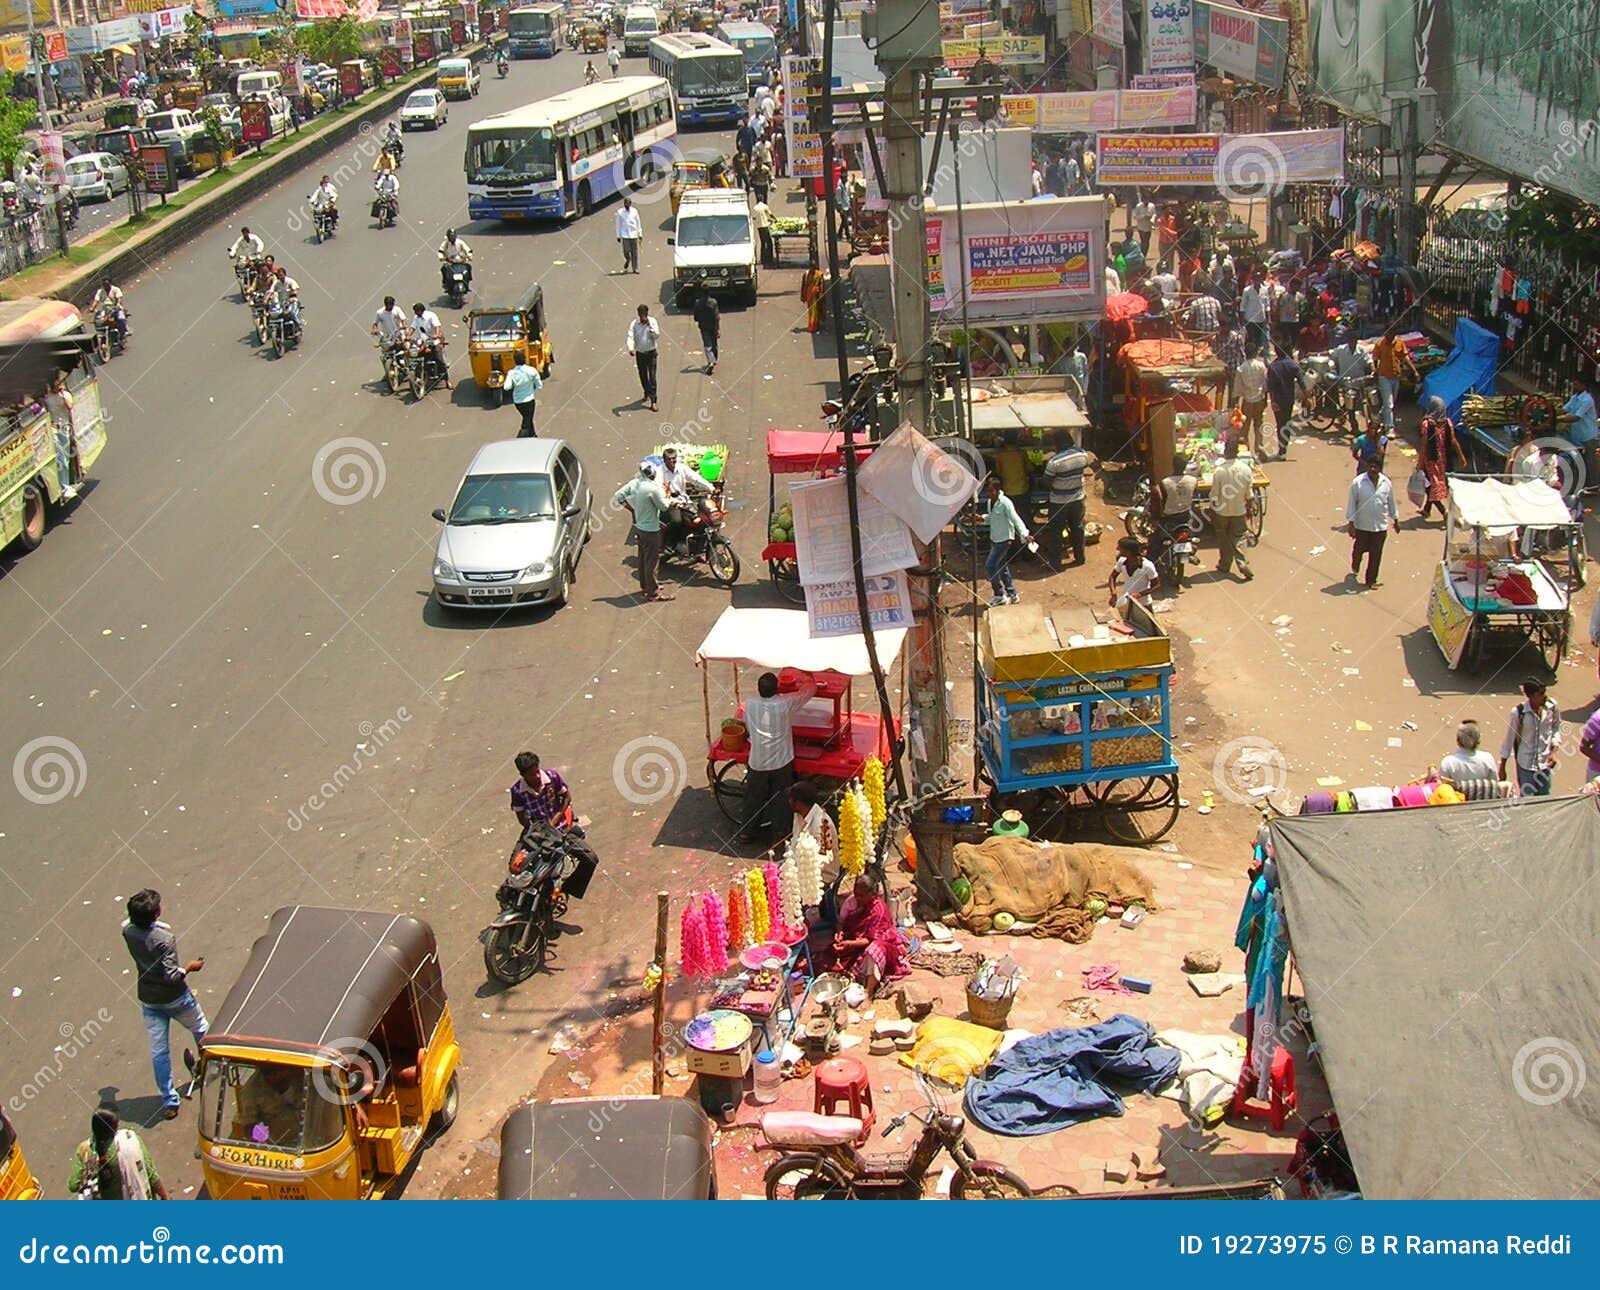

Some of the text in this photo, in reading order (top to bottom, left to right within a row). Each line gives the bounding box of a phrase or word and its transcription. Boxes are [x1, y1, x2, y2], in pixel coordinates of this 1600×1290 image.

[1003, 39, 1028, 52] SAP
[1106, 138, 1214, 147] RAMAIAH
[971, 233, 1087, 247] MINI PROJECTS
[973, 251, 985, 259] on
[1060, 242, 1086, 254] PHP
